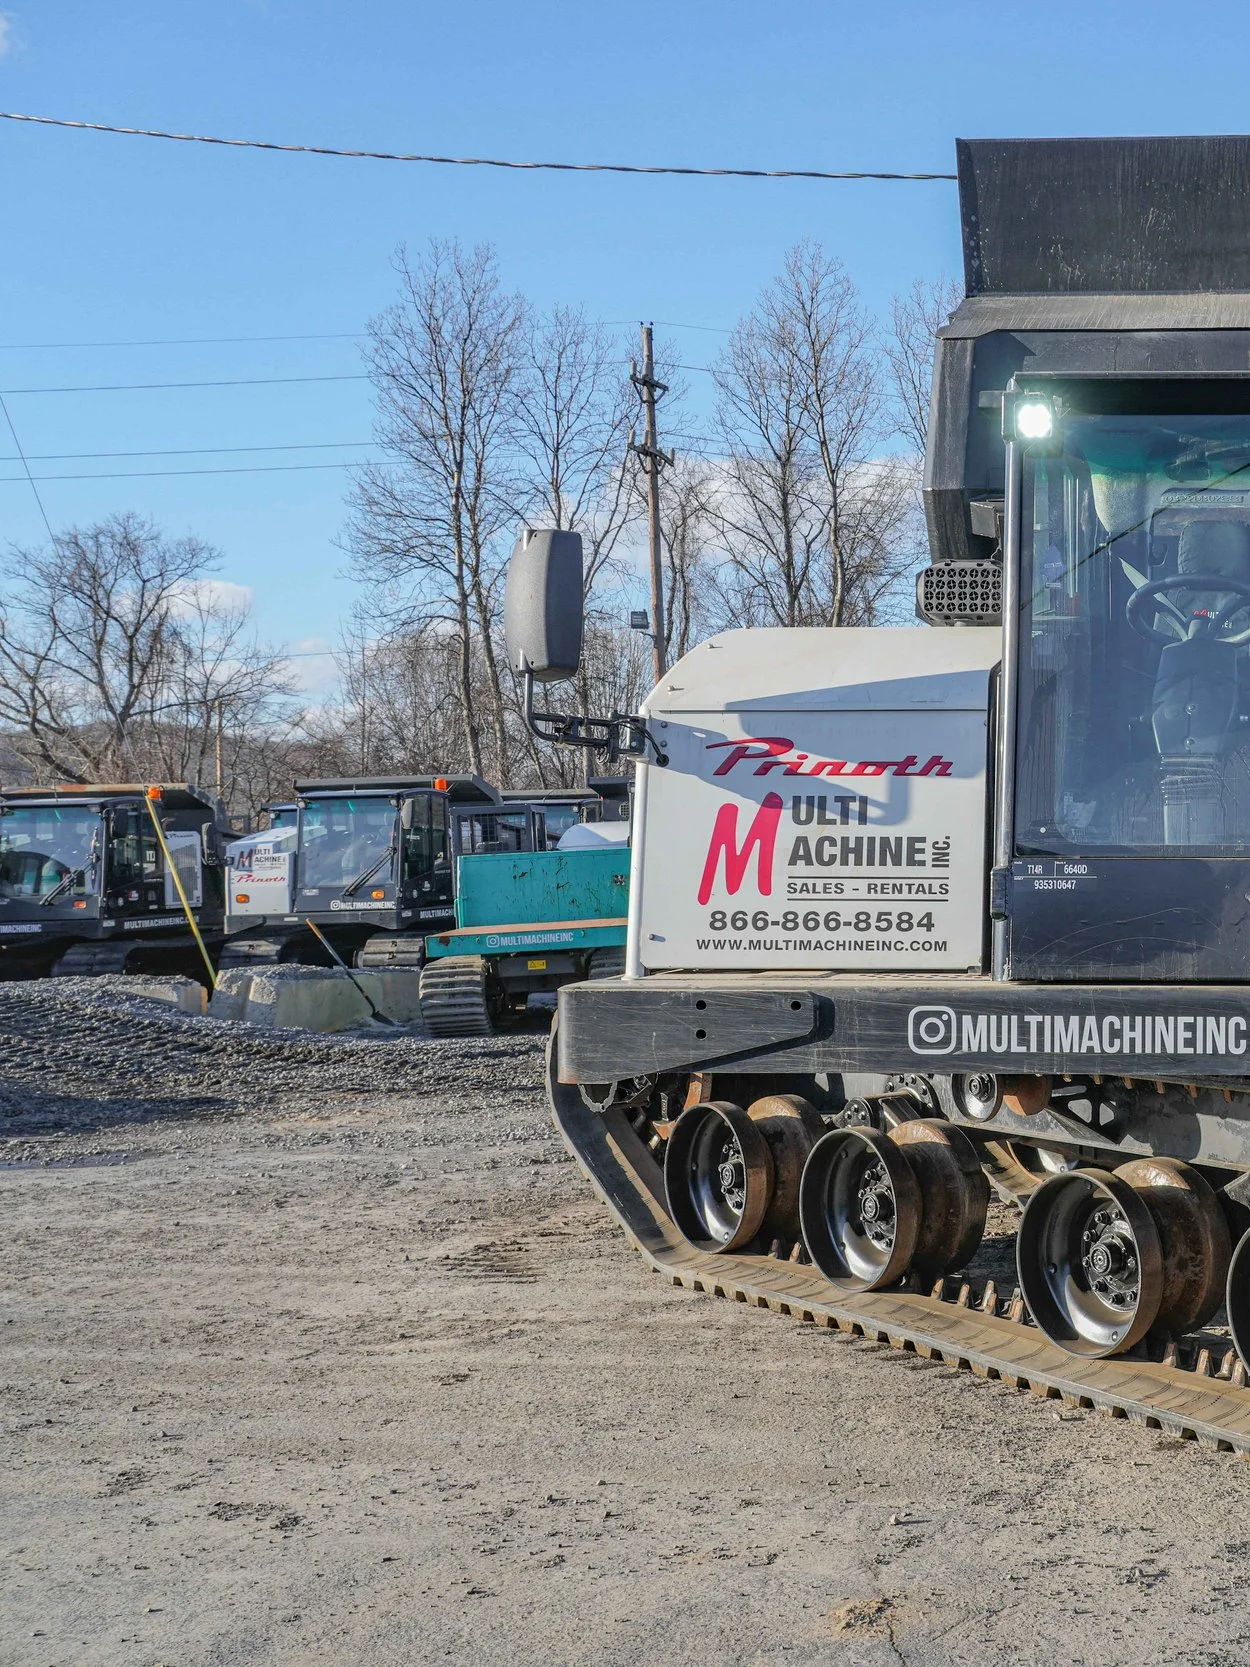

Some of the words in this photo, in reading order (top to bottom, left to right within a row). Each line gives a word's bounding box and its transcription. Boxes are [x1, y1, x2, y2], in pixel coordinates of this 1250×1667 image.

[706, 737, 954, 776] Prinoth
[932, 835, 950, 868] INC.
[1027, 864, 1043, 875] T14R
[1063, 864, 1088, 874] 6640D
[235, 873, 287, 883] Prinoth
[1034, 880, 1077, 890] 935310647
[787, 882, 845, 895] SALES
[867, 883, 950, 895] RENTALS
[124, 916, 199, 930] MULTIMACHINEINC.CM
[709, 910, 935, 932] 866-866-8584
[500, 931, 574, 946] MULTIMACHINEINC
[696, 939, 948, 952] WWW.MULTIMACHINEINC.COM
[962, 1015, 1247, 1054] MULTIMACHINEINC
